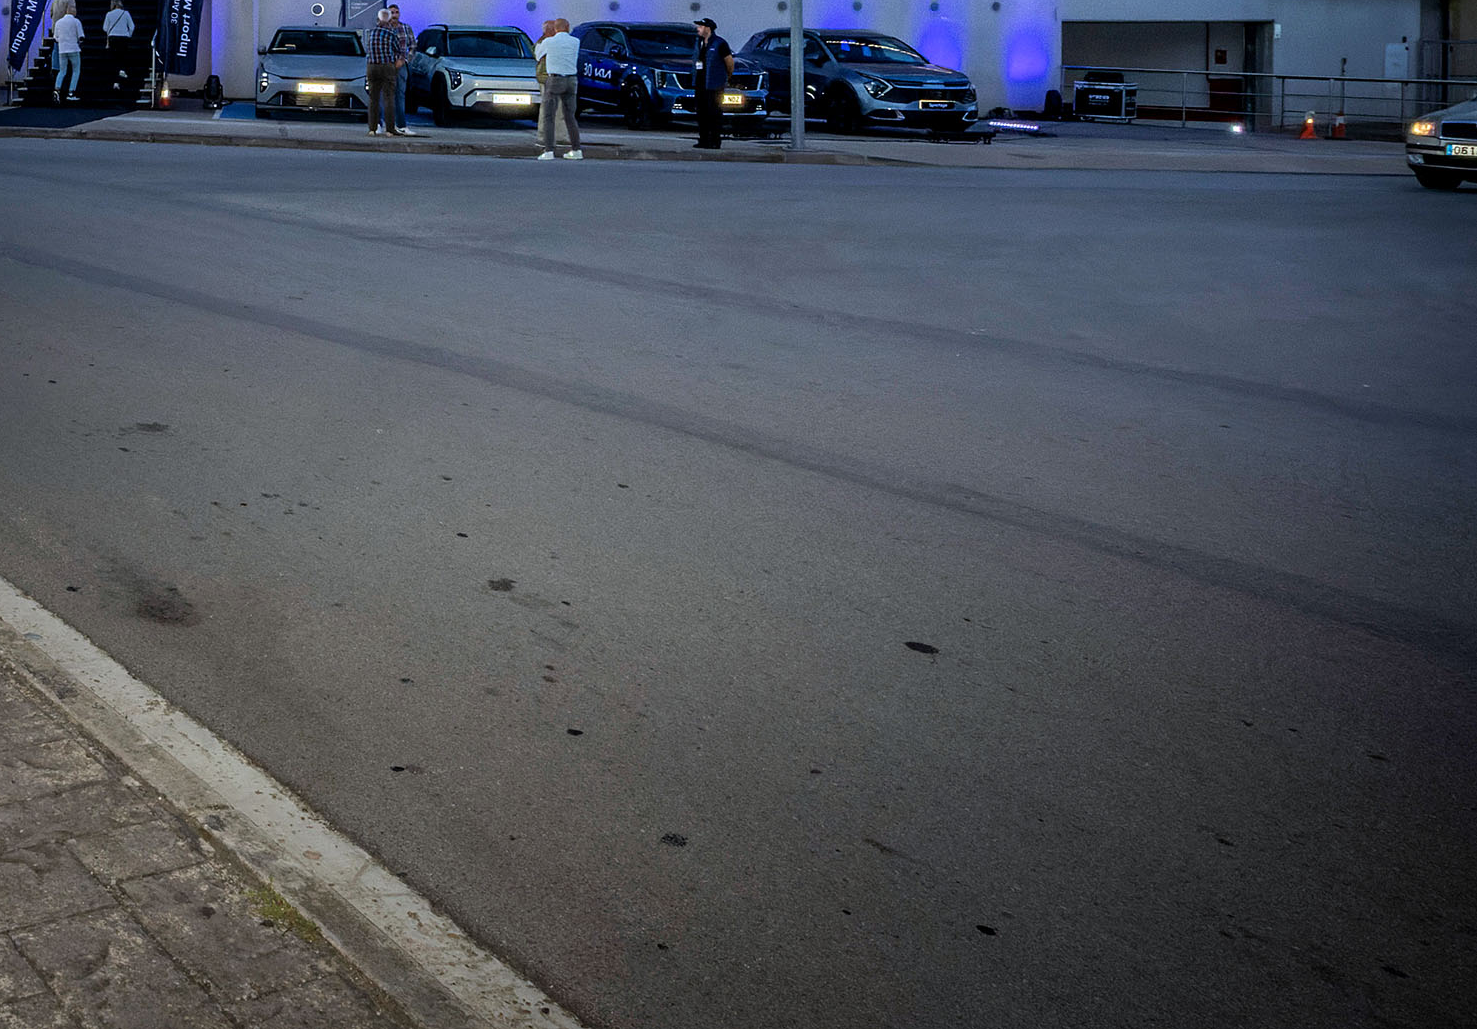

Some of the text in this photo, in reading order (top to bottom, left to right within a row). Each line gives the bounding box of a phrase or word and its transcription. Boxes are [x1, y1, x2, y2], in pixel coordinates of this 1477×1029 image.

[170, 11, 178, 25] 30
[10, 12, 33, 54] Import
[176, 13, 191, 58] Import
[584, 62, 612, 79] 30 KIA
